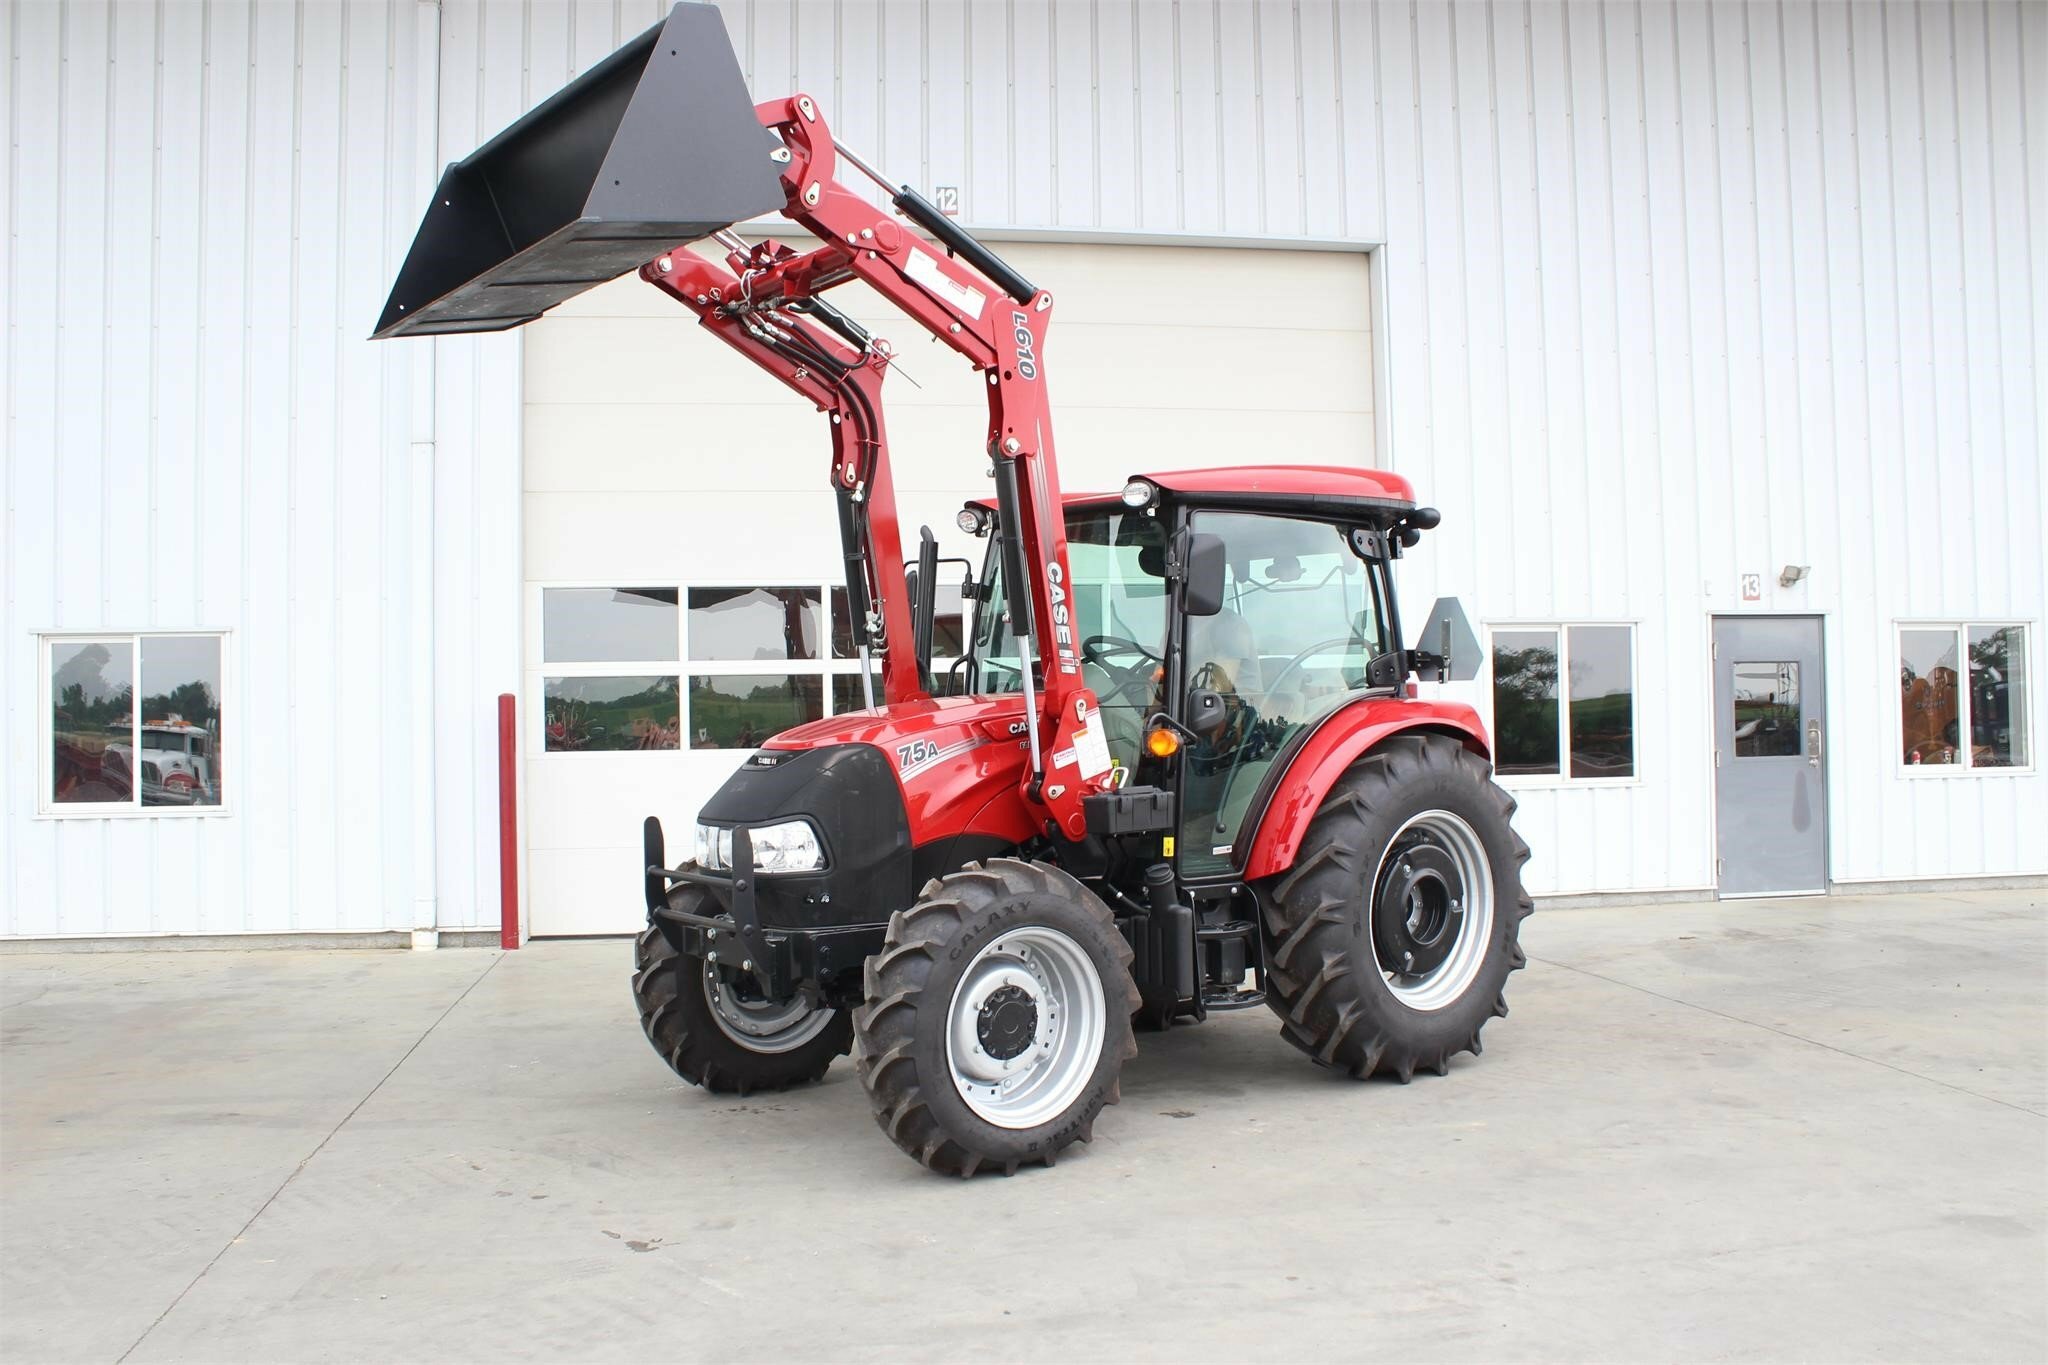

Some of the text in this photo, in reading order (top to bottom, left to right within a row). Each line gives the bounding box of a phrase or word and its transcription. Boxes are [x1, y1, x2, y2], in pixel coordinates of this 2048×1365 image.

[936, 188, 957, 211] 12
[1011, 311, 1037, 381] L610
[1047, 561, 1072, 645] CASE
[1742, 575, 1760, 597] 13
[896, 739, 940, 769] 75A
[950, 901, 1031, 960] GALAXY
